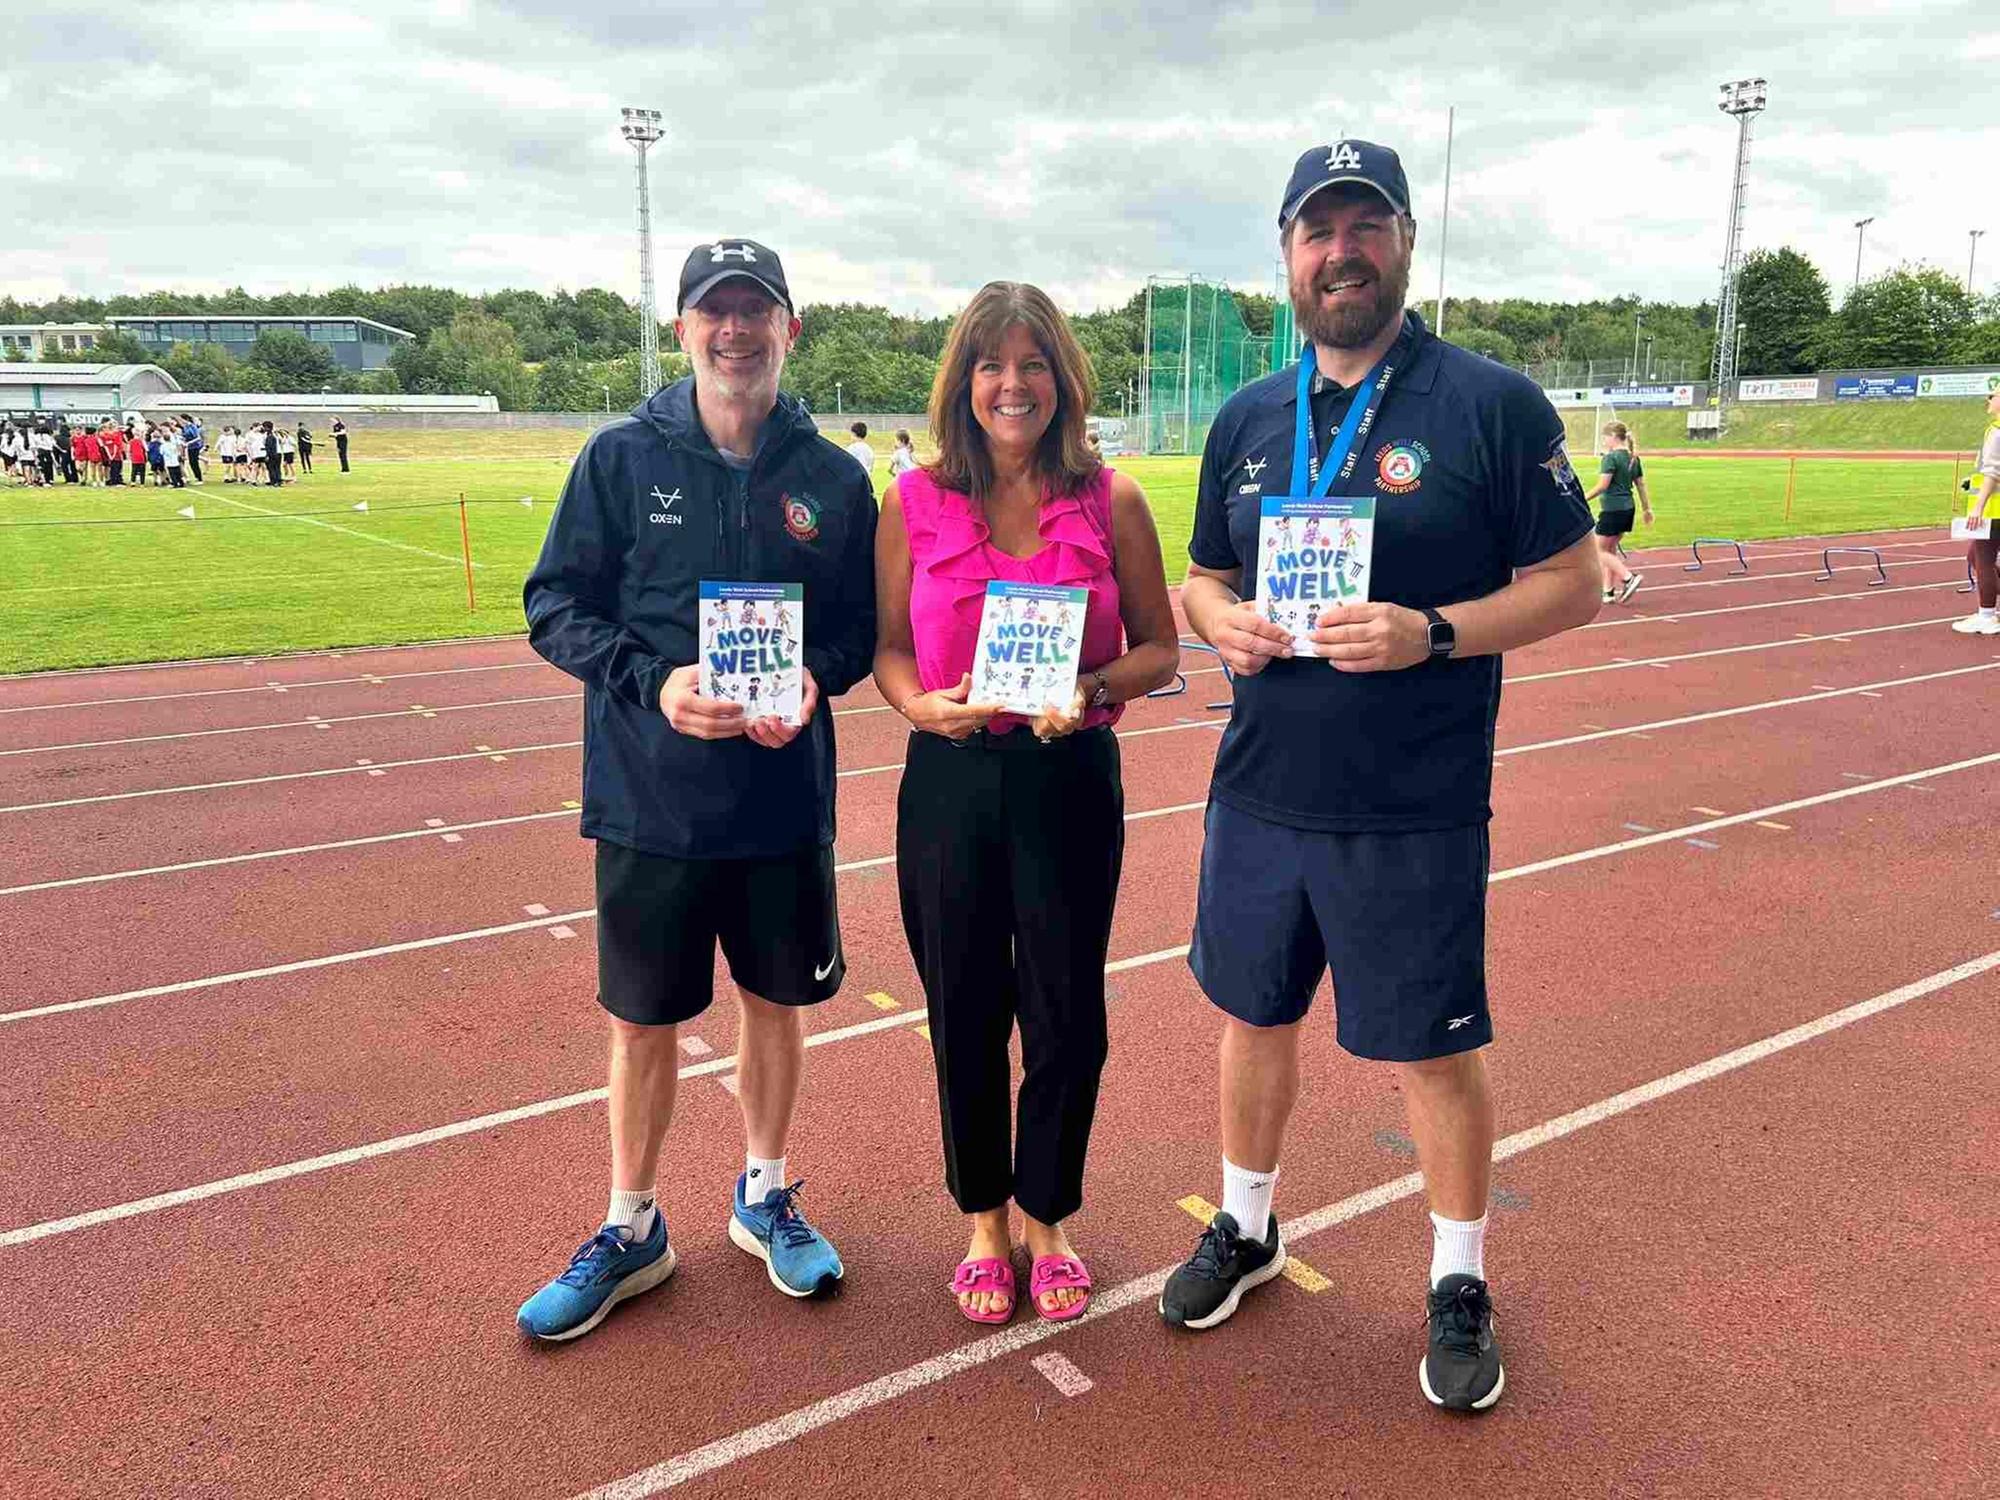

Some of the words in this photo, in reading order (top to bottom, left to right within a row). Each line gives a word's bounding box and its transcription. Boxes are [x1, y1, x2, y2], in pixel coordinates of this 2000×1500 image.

[1325, 141, 1361, 171] LA
[1376, 365, 1394, 391] Staff
[64, 413, 116, 424] VISITO
[1358, 408, 1374, 434] Staff
[1341, 452, 1357, 478] Staff
[1374, 476, 1421, 494] PARTNERSHIP
[650, 513, 682, 525] OXEN
[1276, 548, 1347, 572] MOVE
[1267, 571, 1358, 601] WELL
[717, 627, 783, 649] MOVE
[997, 622, 1062, 640] MOVE
[708, 644, 793, 674] WELL
[987, 641, 1070, 664] WELL
